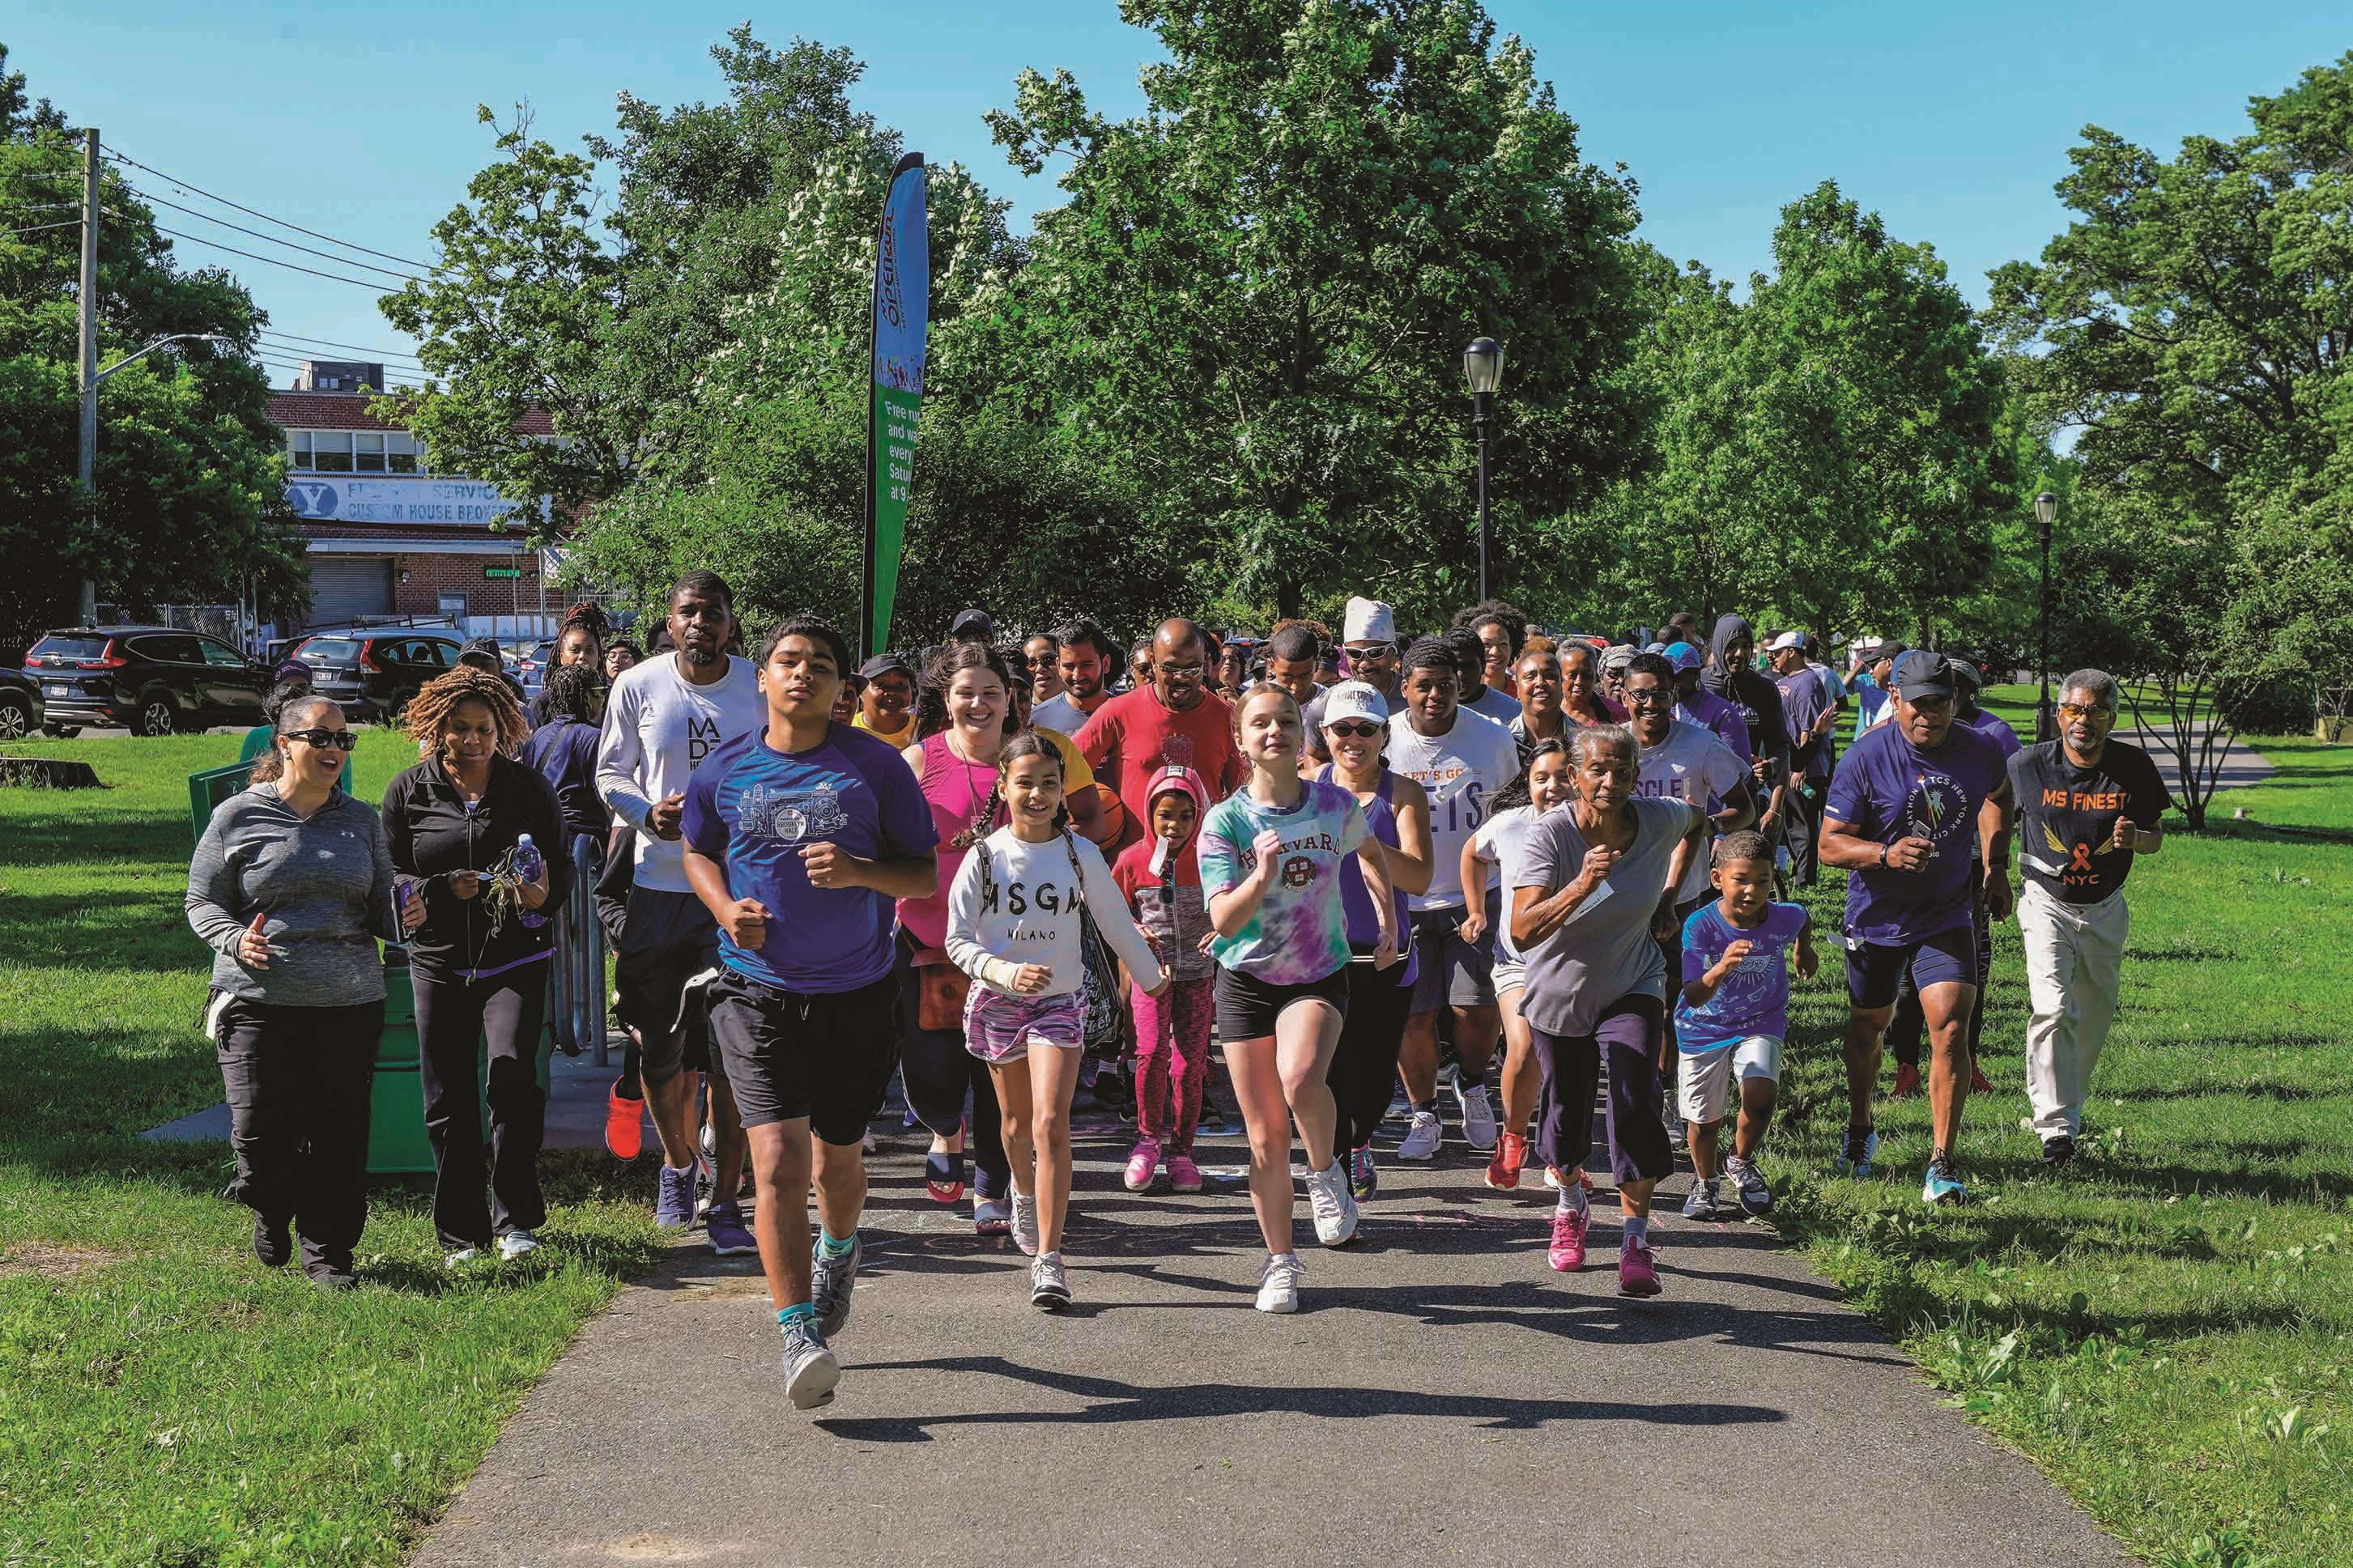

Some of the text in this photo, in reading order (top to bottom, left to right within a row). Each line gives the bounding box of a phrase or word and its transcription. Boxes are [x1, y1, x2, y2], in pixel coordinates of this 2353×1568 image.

[884, 401, 907, 419] Free
[887, 423, 905, 440] and
[889, 444, 912, 465] every
[891, 485, 898, 499] at
[348, 503, 513, 521] CUSM HOUSE BROK
[687, 716, 721, 739] MA
[1906, 776, 1968, 839] TCS NEW YORK CIT RATHON
[2041, 788, 2127, 812] MS FINEST
[777, 821, 804, 829] BROOKLYN
[1240, 831, 1340, 870] HVAR
[2062, 873, 2100, 886] NYC
[1007, 927, 1056, 941] MILANO
